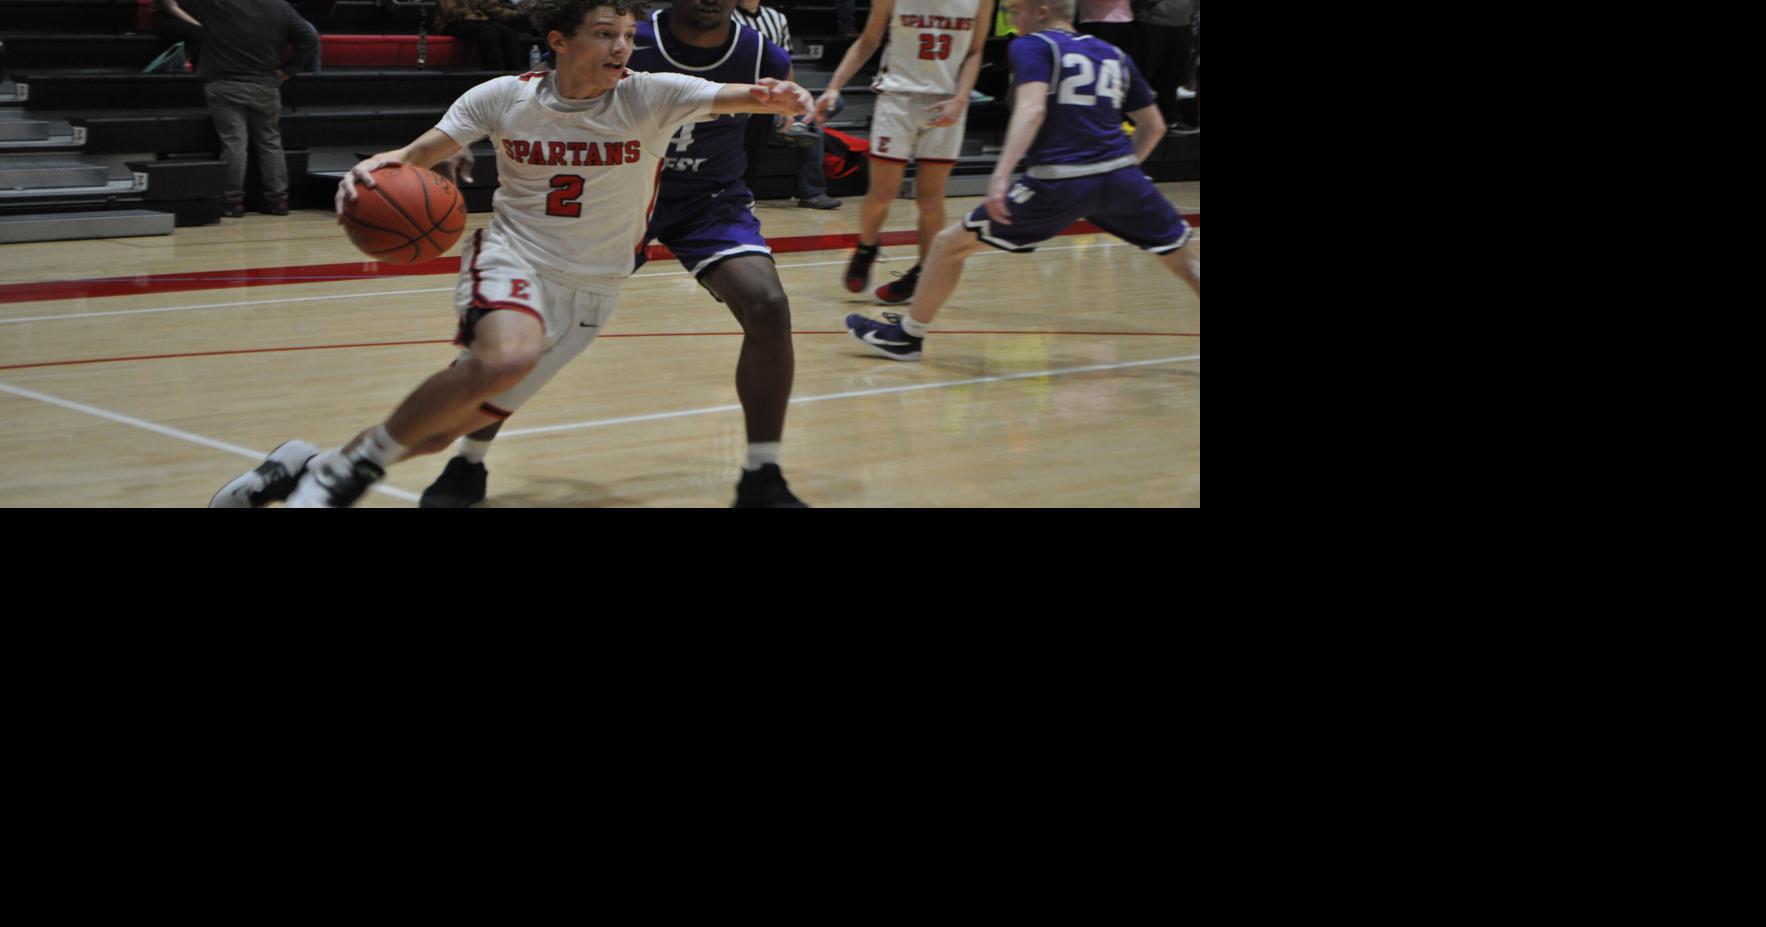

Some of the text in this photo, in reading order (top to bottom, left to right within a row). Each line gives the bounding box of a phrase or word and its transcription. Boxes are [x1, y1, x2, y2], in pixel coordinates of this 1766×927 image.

[900, 14, 975, 30] SPARTANS
[918, 33, 952, 60] 23
[1058, 52, 1124, 109] 24
[501, 139, 641, 166] SPARTANS
[664, 157, 708, 172] EST
[545, 174, 585, 218] 2
[510, 278, 531, 300] E
